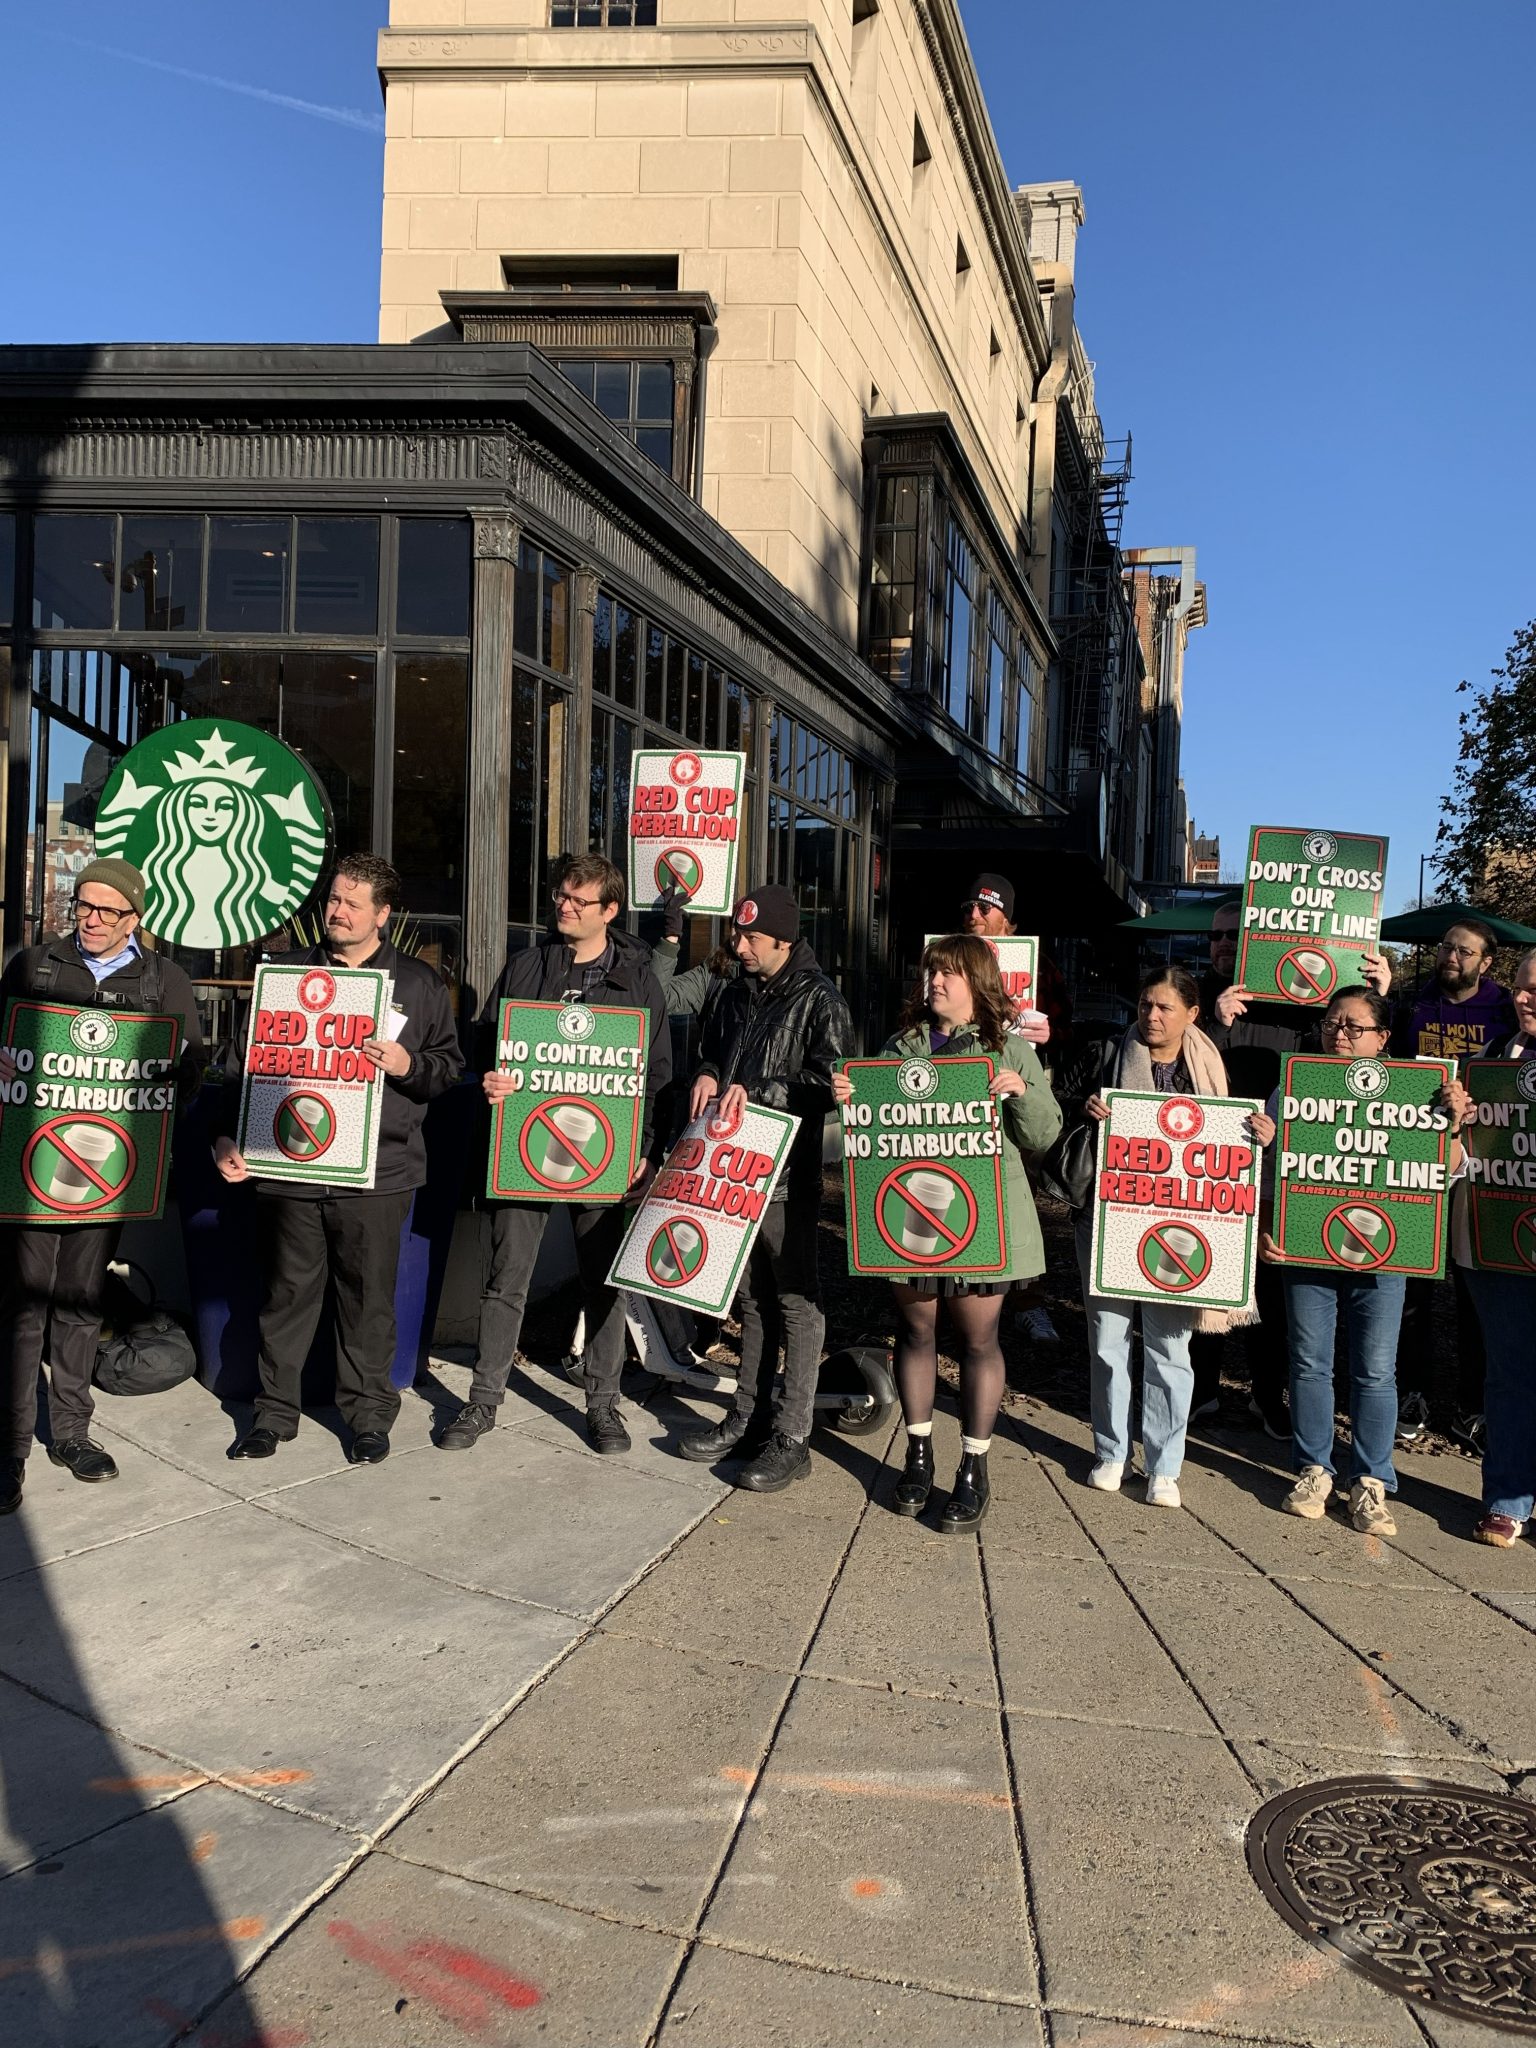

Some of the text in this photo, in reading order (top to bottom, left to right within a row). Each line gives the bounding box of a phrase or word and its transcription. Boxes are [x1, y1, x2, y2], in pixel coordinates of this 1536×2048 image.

[634, 786, 736, 814] RED CUP
[630, 814, 737, 841] REBELLION
[1249, 860, 1382, 892] DON'T CROSS
[1291, 886, 1336, 909] OUR
[1244, 907, 1378, 940] PICKET LINE
[1251, 933, 1297, 942] BARISTAS
[1299, 936, 1313, 944] ON
[1333, 940, 1367, 950] STRIKE
[1000, 971, 1032, 998] UP
[78, 1013, 112, 1027] STARBUCKS
[255, 1010, 377, 1049] RED CUP
[42, 1052, 172, 1082] CONTRACT
[248, 1045, 376, 1083] REBELLION
[499, 1040, 645, 1072] NO CONTRACT,
[902, 1060, 932, 1072] STARBUCKS
[1352, 1061, 1384, 1073] STARBUCKS
[34, 1082, 174, 1111] STARBUCKS!
[254, 1078, 279, 1086] UNFAIR
[302, 1081, 337, 1090] PRACTICE
[529, 1069, 645, 1097] STARBUCKS!
[924, 1077, 936, 1095] UNITED
[1348, 1077, 1386, 1096] WORKERS UNITED
[842, 1100, 1000, 1128] NO CONTRACT,
[1165, 1100, 1198, 1113] STARBUCKS
[1283, 1096, 1448, 1131] DON'T CROSS
[843, 1131, 1002, 1158] NO STARBUCKS!
[1335, 1127, 1389, 1155] OUR
[709, 1143, 774, 1187] CUP
[1106, 1135, 1254, 1181] RED CUP
[1280, 1151, 1445, 1190] PICKET LINE
[1469, 1157, 1536, 1188] PICKE
[1099, 1170, 1256, 1216] REBELLION
[1290, 1184, 1433, 1205] BARISTAS ON ULP STRIKE
[664, 1202, 685, 1212] LABOR
[685, 1206, 719, 1220] PRACTICE
[719, 1216, 746, 1229] STRIKE
[1109, 1205, 1244, 1224] UNFAIR LABOR PRACTICE STRIKE
[631, 1302, 641, 1324] Lime
